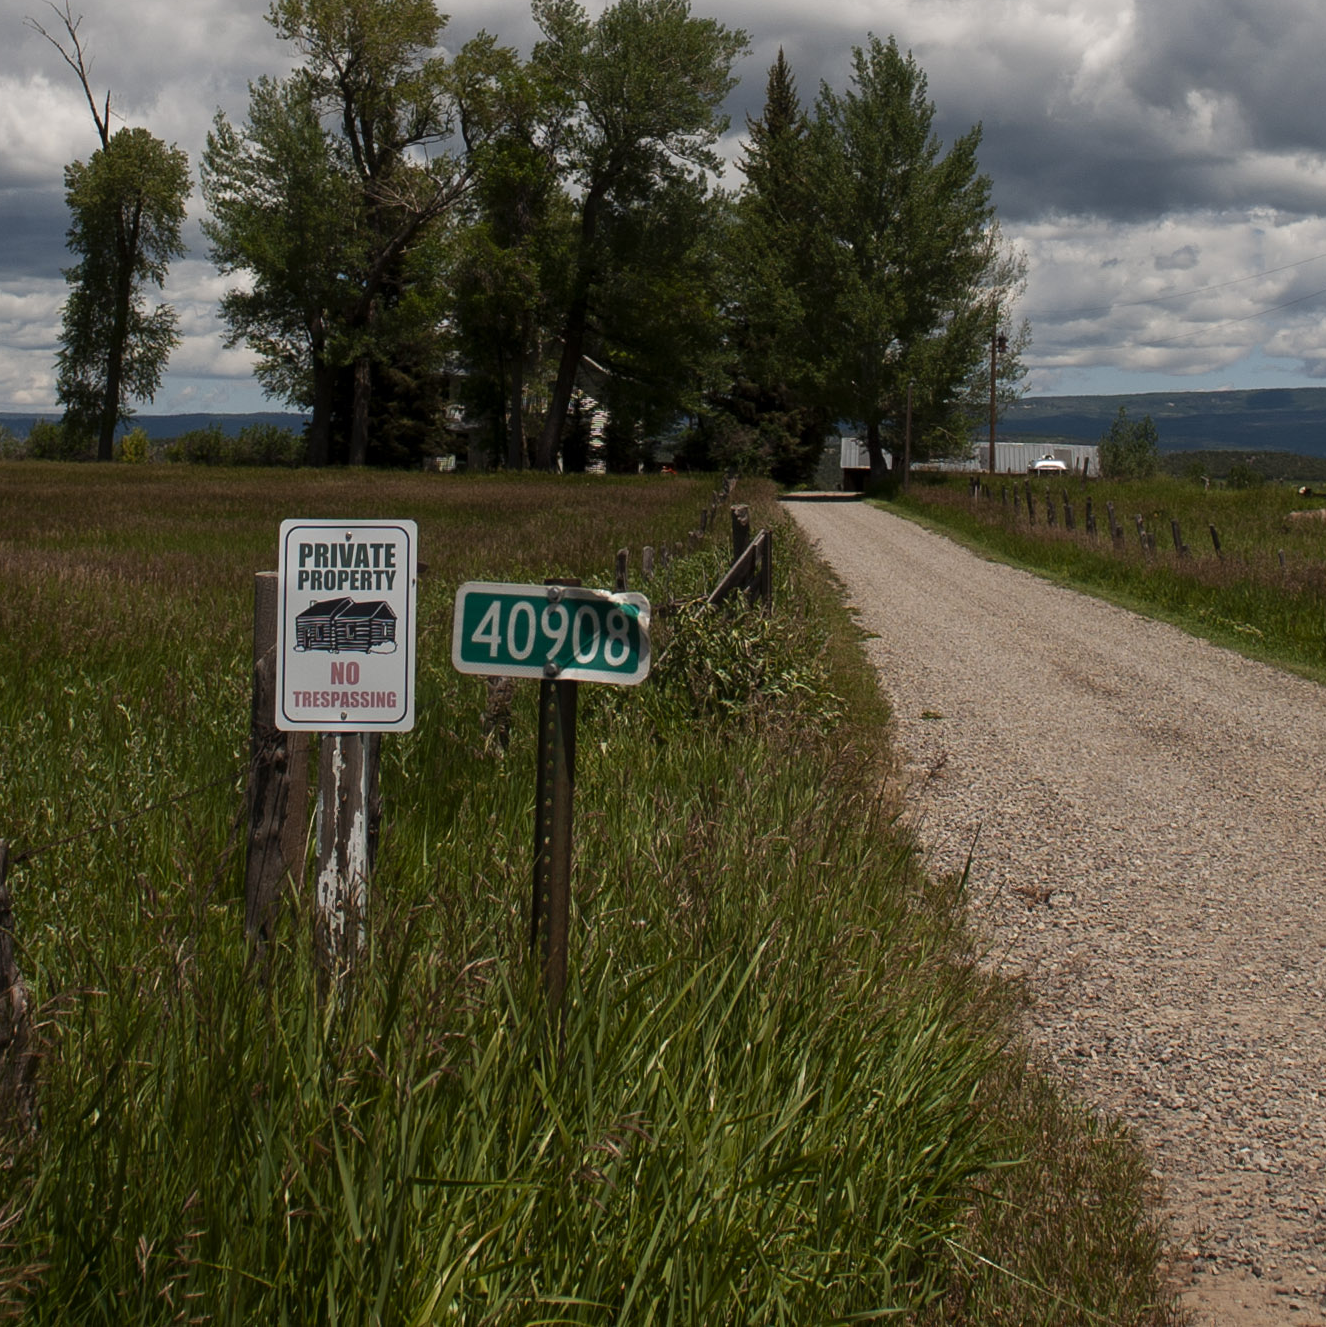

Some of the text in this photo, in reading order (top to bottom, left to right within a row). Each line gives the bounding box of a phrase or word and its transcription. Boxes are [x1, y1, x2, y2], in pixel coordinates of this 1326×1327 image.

[299, 543, 396, 568] PRIVATE
[298, 570, 396, 591] PROPERTY
[471, 600, 631, 667] 40908
[330, 662, 360, 685] NO
[293, 691, 397, 708] TRESPASSING
